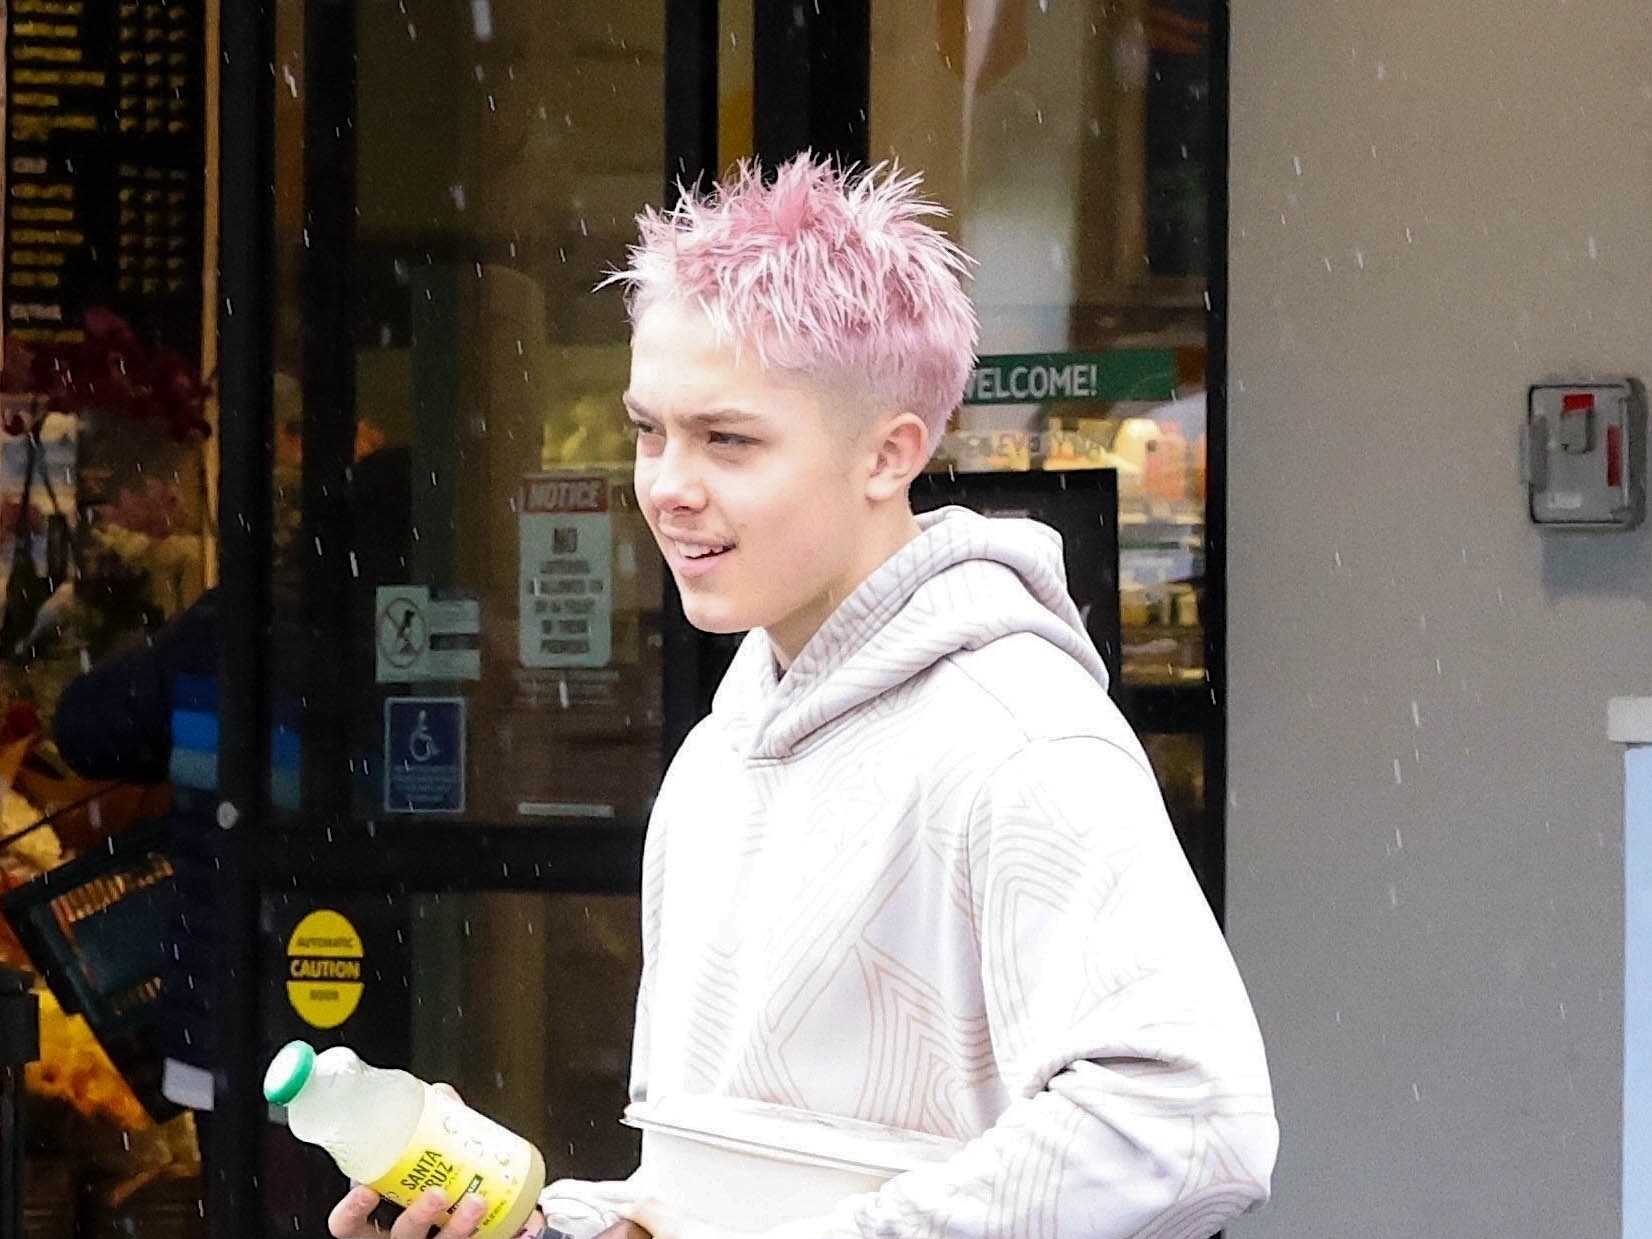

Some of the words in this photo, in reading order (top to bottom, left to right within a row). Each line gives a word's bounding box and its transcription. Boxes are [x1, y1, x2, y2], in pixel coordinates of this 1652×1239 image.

[531, 481, 600, 510] NOTICE
[290, 959, 361, 978] CAUTION
[401, 1150, 442, 1191] SANTA
